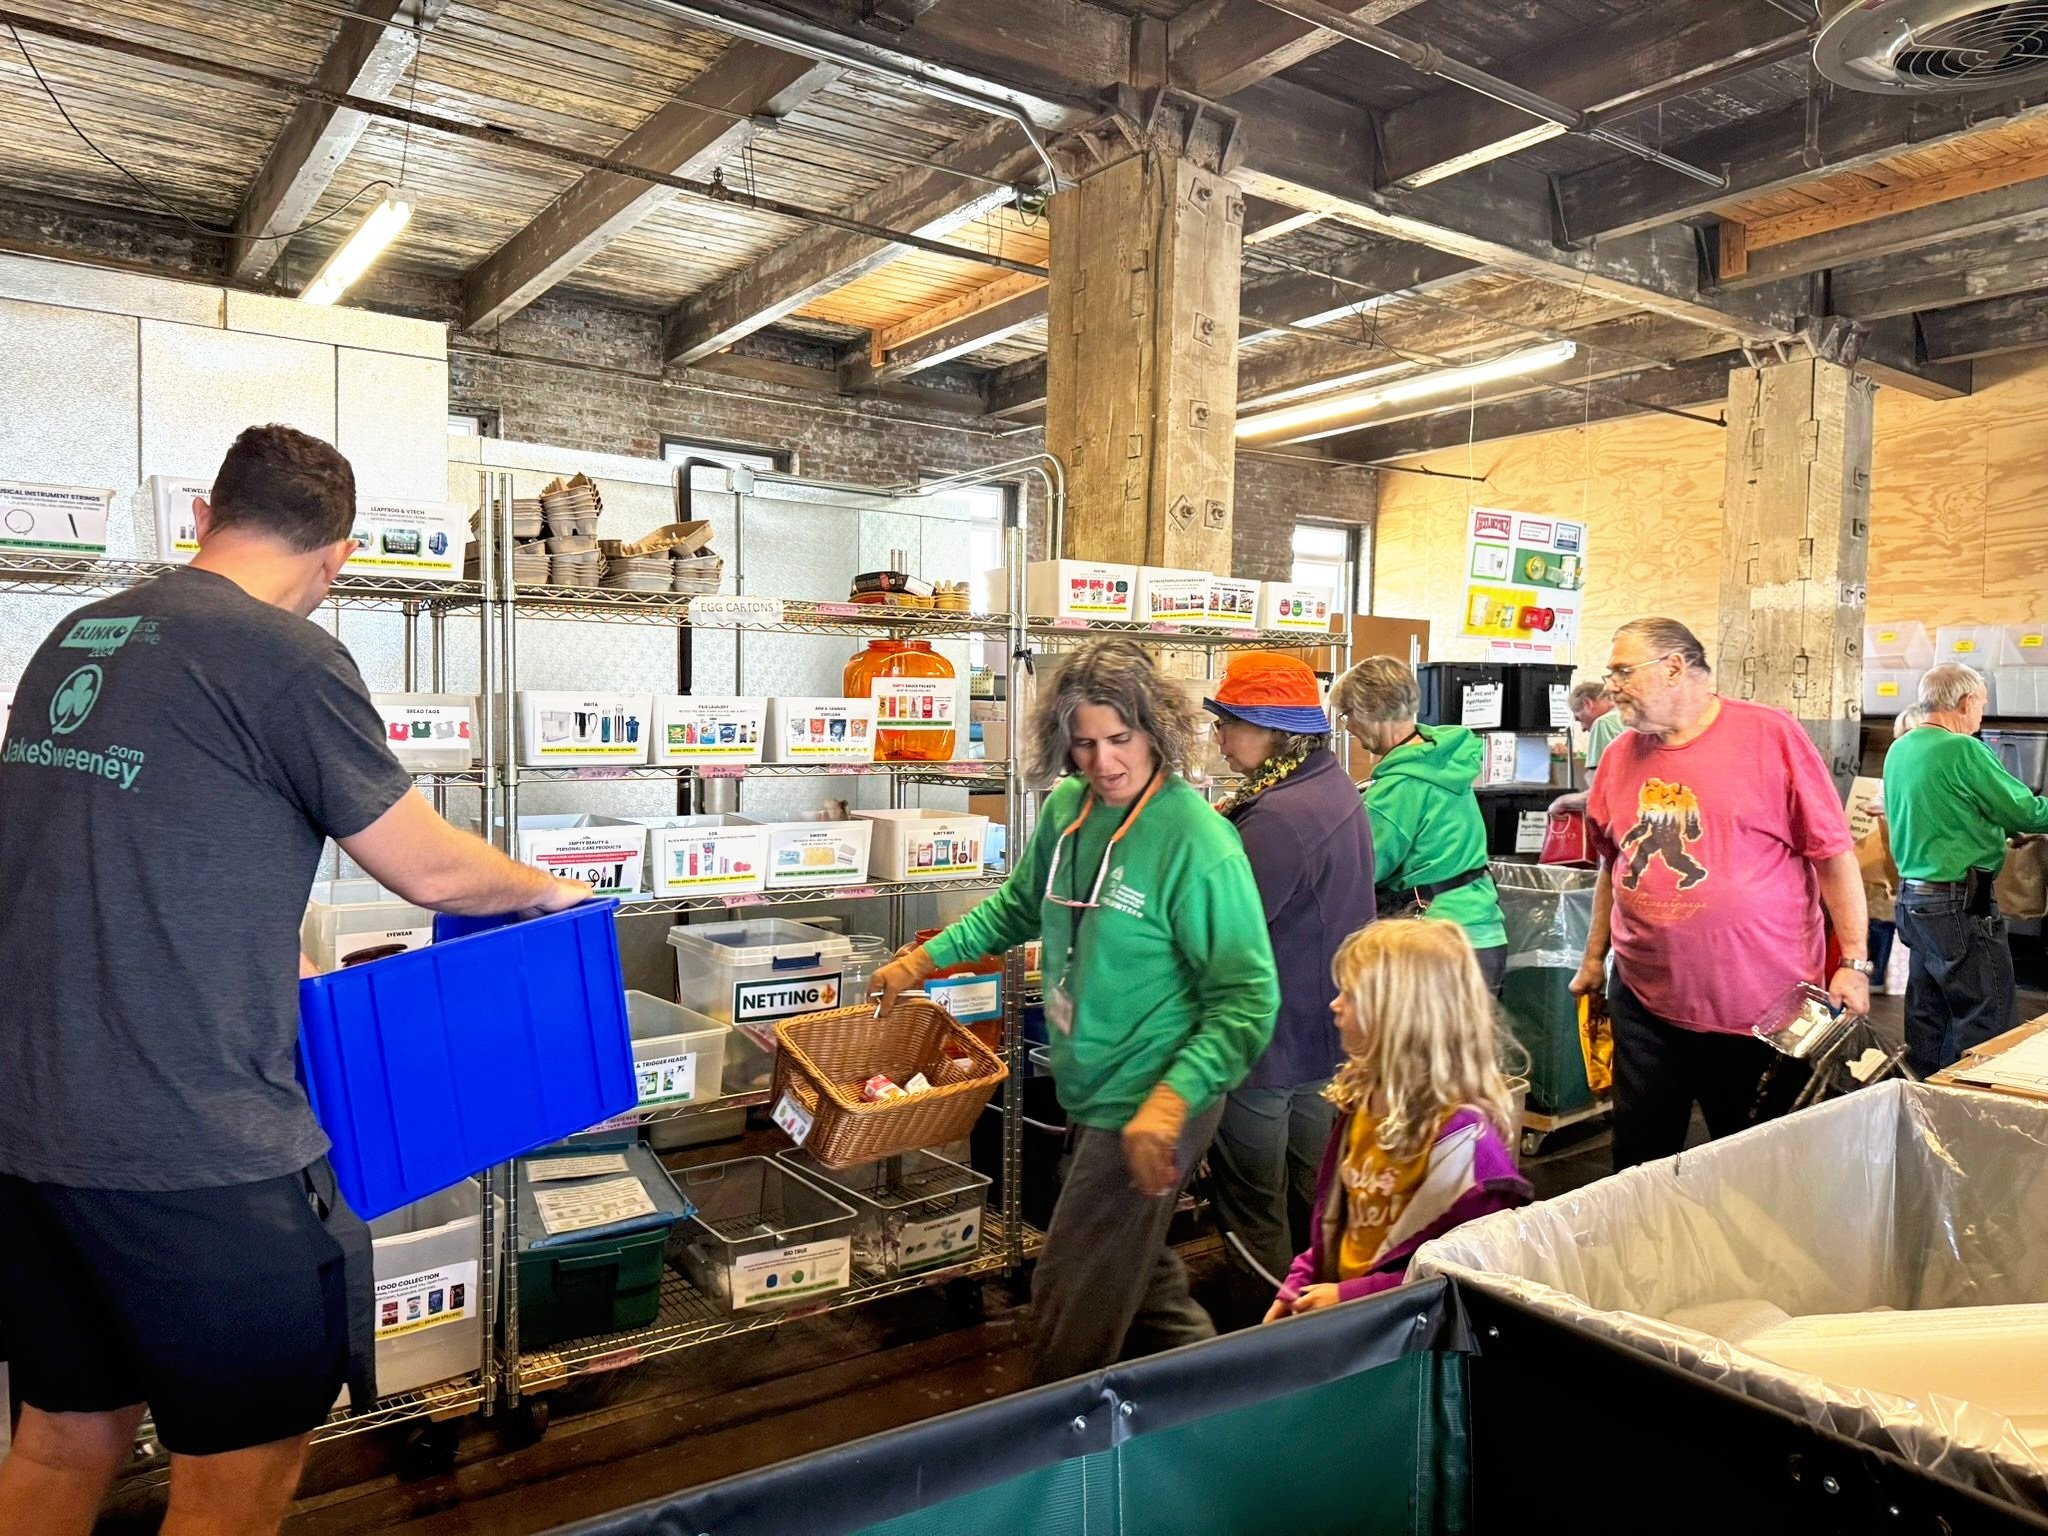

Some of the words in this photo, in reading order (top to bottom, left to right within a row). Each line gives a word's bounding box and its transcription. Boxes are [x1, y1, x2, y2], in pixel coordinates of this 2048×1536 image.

[24, 490, 70, 499] INSTRUMENT
[71, 494, 100, 502] STRINGS
[370, 506, 400, 514] LEAPFROG
[700, 602, 723, 613] EGG
[726, 602, 774, 613] CARTONS
[742, 988, 819, 1010] NETTING
[642, 1059, 667, 1068] TRIGGER
[668, 1055, 688, 1063] HEADS
[376, 1282, 397, 1292] FOOD
[398, 1272, 440, 1288] COLLECTION
